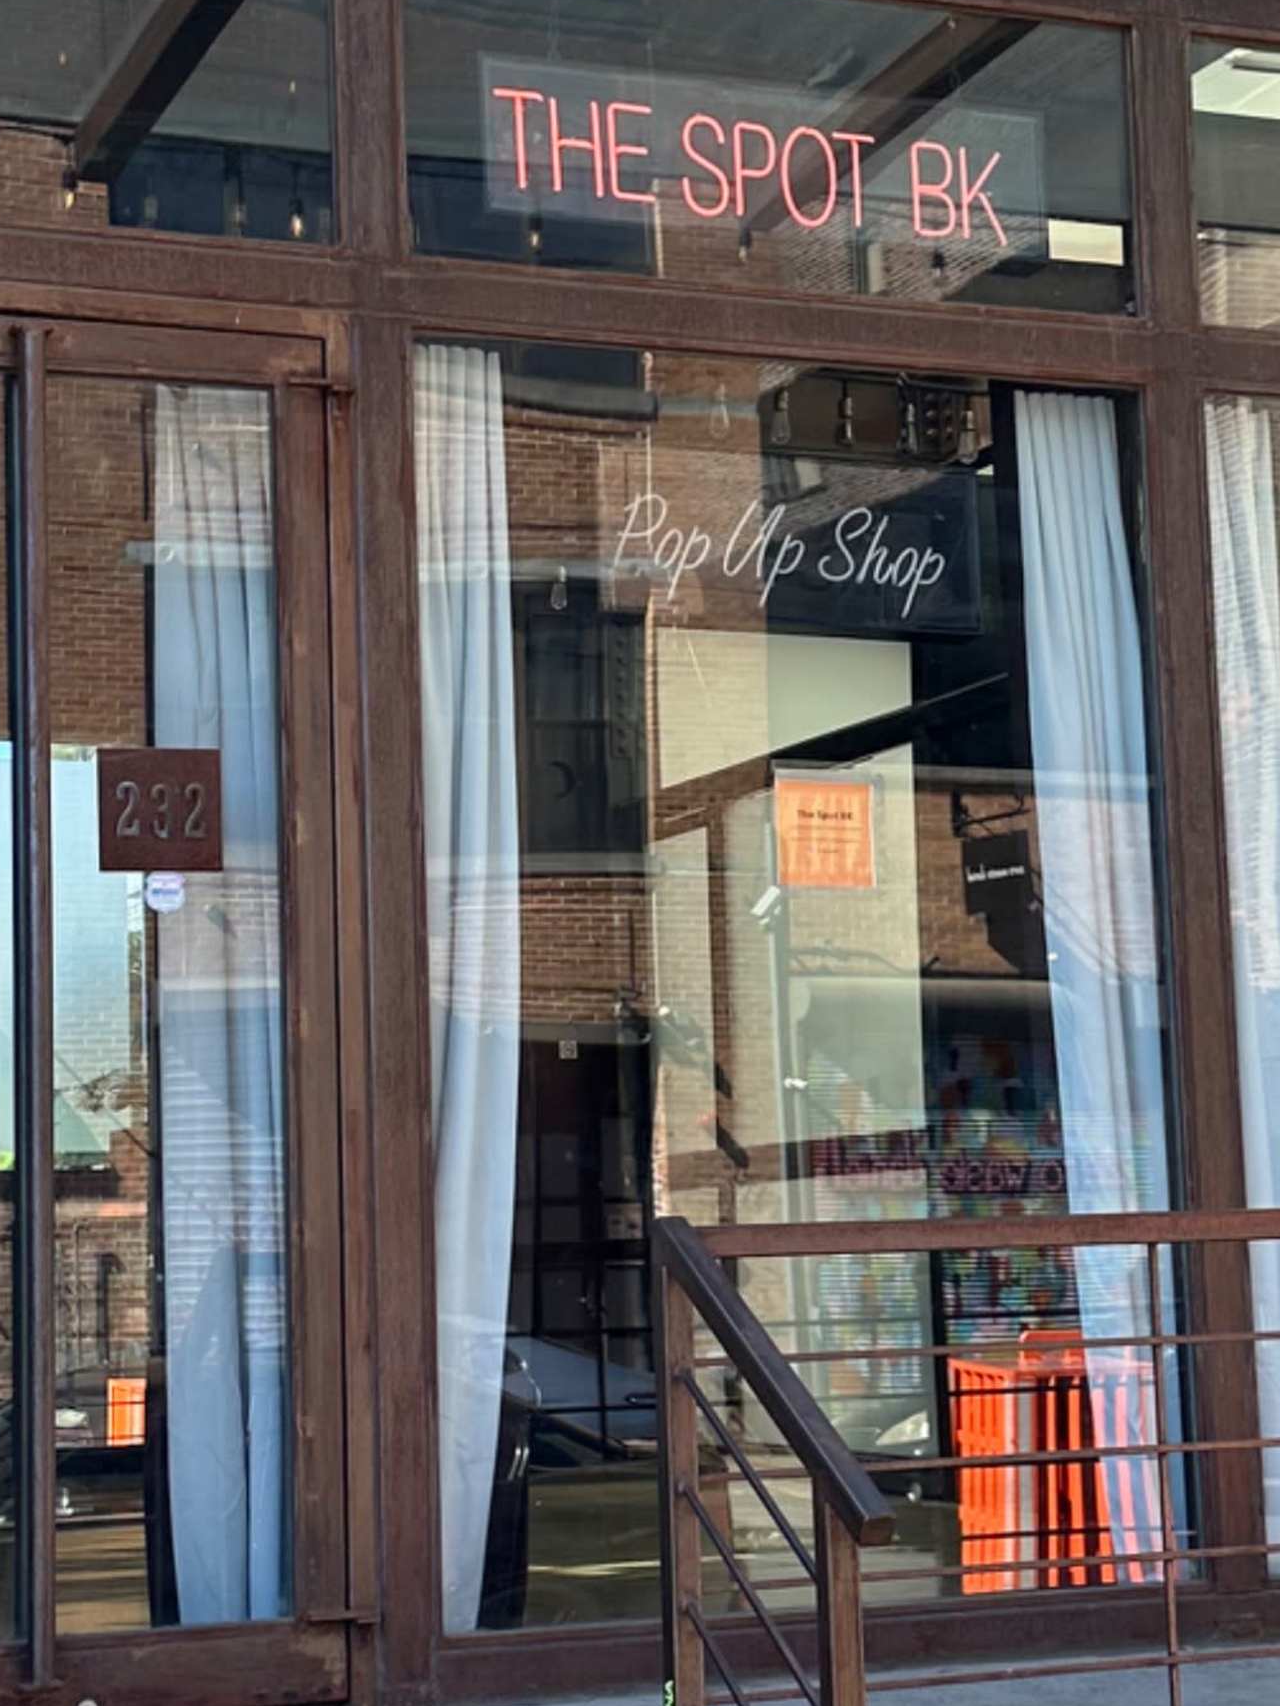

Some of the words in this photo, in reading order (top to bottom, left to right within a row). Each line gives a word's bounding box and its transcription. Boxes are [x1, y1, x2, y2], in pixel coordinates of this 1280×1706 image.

[493, 87, 657, 204] THE
[680, 113, 875, 230] SPOT
[908, 141, 1008, 247] BK
[614, 493, 710, 602] Pop
[722, 503, 805, 608] Up
[818, 506, 947, 619] Shop
[115, 780, 209, 839] 232
